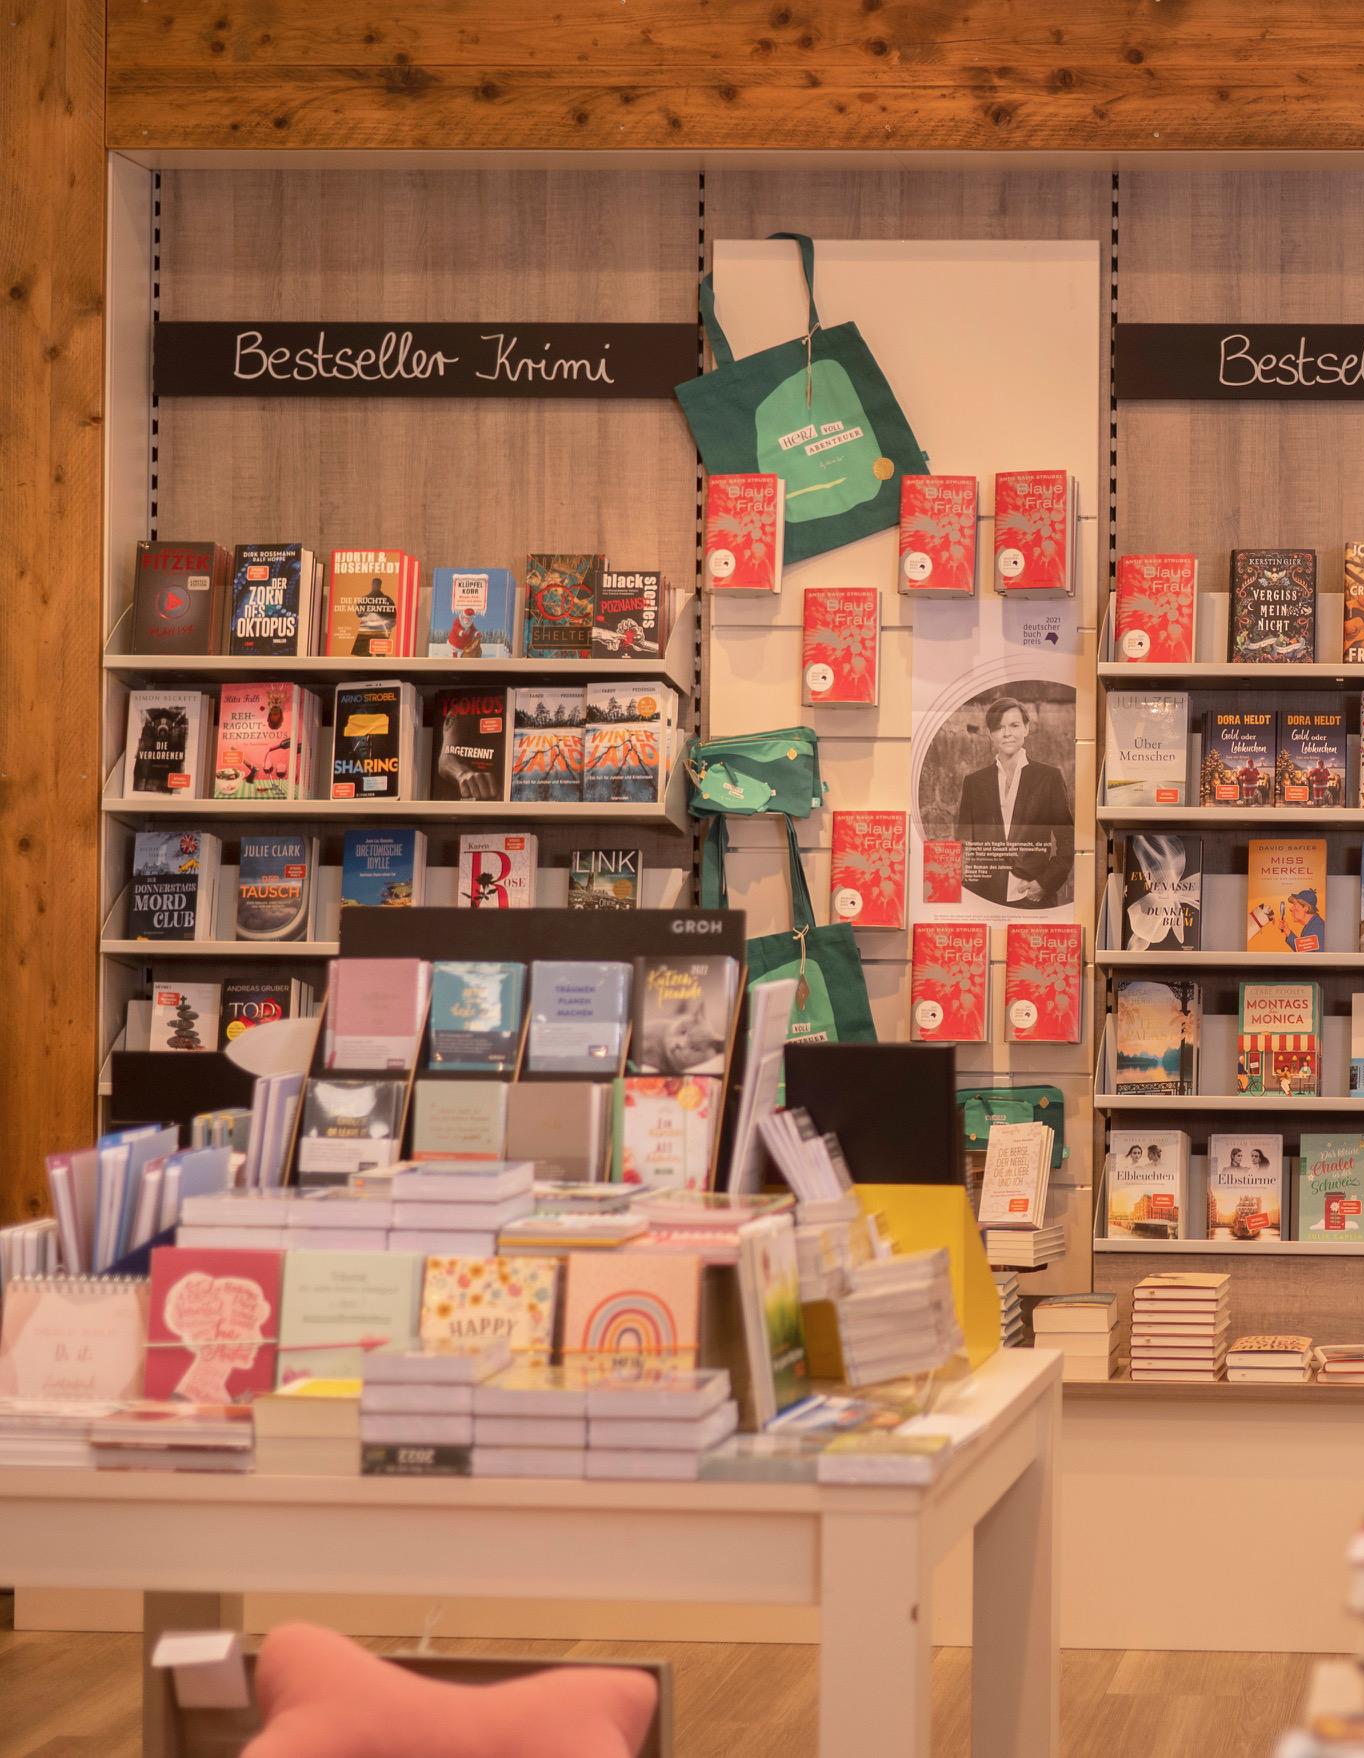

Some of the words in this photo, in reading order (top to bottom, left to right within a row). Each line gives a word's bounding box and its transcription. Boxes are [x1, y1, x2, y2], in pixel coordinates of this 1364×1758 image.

[234, 331, 459, 380] Bestseller
[476, 335, 615, 383] Krimi
[823, 424, 840, 432] VOLL
[810, 430, 860, 453] ABENTEUER
[728, 486, 774, 498] Blaue
[925, 487, 973, 500] Blaue
[1017, 483, 1063, 496] Blaue
[737, 500, 774, 512] Frau
[935, 502, 973, 514] Frau
[1026, 498, 1064, 509] Frau
[335, 552, 375, 562] HJORTH
[143, 554, 210, 573] FITZEK
[335, 562, 400, 574] ROSENFELDT
[1144, 567, 1191, 578] Blaue
[272, 578, 287, 589] DER
[1152, 581, 1191, 592] Frau
[249, 586, 283, 605] ZORN
[1253, 589, 1297, 601] VERGISS
[603, 574, 643, 588] black
[643, 576, 656, 628] stories
[826, 600, 874, 611] Blaue
[244, 605, 265, 618] DES
[1260, 605, 1287, 616] MEIN
[835, 614, 874, 626] Frau
[237, 617, 295, 638] OKTOPUS
[1024, 638, 1041, 646] preis
[341, 694, 362, 703] ARNO
[364, 692, 396, 701] STROBEL
[442, 696, 503, 716] TSOKOS
[231, 712, 255, 720] REH-
[1217, 715, 1240, 724] DORA
[1244, 715, 1271, 725] HELDT
[1288, 716, 1310, 725] DORA
[1315, 716, 1341, 725] HELDT
[223, 722, 265, 730] RAGOUT-
[222, 731, 288, 740] RENDEZVOUS
[591, 730, 657, 743] WINTER
[156, 742, 168, 750] DIE
[519, 735, 584, 748] WINTER
[1134, 738, 1162, 749] Über
[139, 751, 184, 760] VERLORENEN
[586, 742, 659, 769] LAND
[1120, 751, 1175, 762] Menschen
[334, 758, 398, 774] SHARING
[856, 824, 903, 835] Blaue
[864, 838, 903, 849] Frau
[244, 845, 269, 857] JULIE
[272, 845, 300, 856] CLARK
[575, 852, 635, 873] LINK
[1271, 856, 1303, 864] MISS
[1261, 866, 1313, 875] MERKEL
[240, 886, 299, 897] TAUSCH
[1144, 882, 1196, 891] MENASSE
[134, 894, 186, 911] MORD
[154, 912, 194, 927] CLUB
[1162, 917, 1193, 927] BLUM
[672, 920, 722, 933] GROH
[936, 936, 983, 947] Blaue
[1030, 937, 1077, 947] Blaue
[945, 950, 983, 961] Frau
[1039, 951, 1077, 962] Frau
[1247, 1000, 1309, 1009] MONTAGS
[1252, 1015, 1304, 1024] MONICA
[1310, 1158, 1354, 1176] Chalet
[1116, 1171, 1174, 1181] Elbleuchten
[1218, 1174, 1276, 1185] Elbstürme
[1311, 1176, 1360, 1195] Schweiz
[450, 1318, 520, 1339] HAPPY
